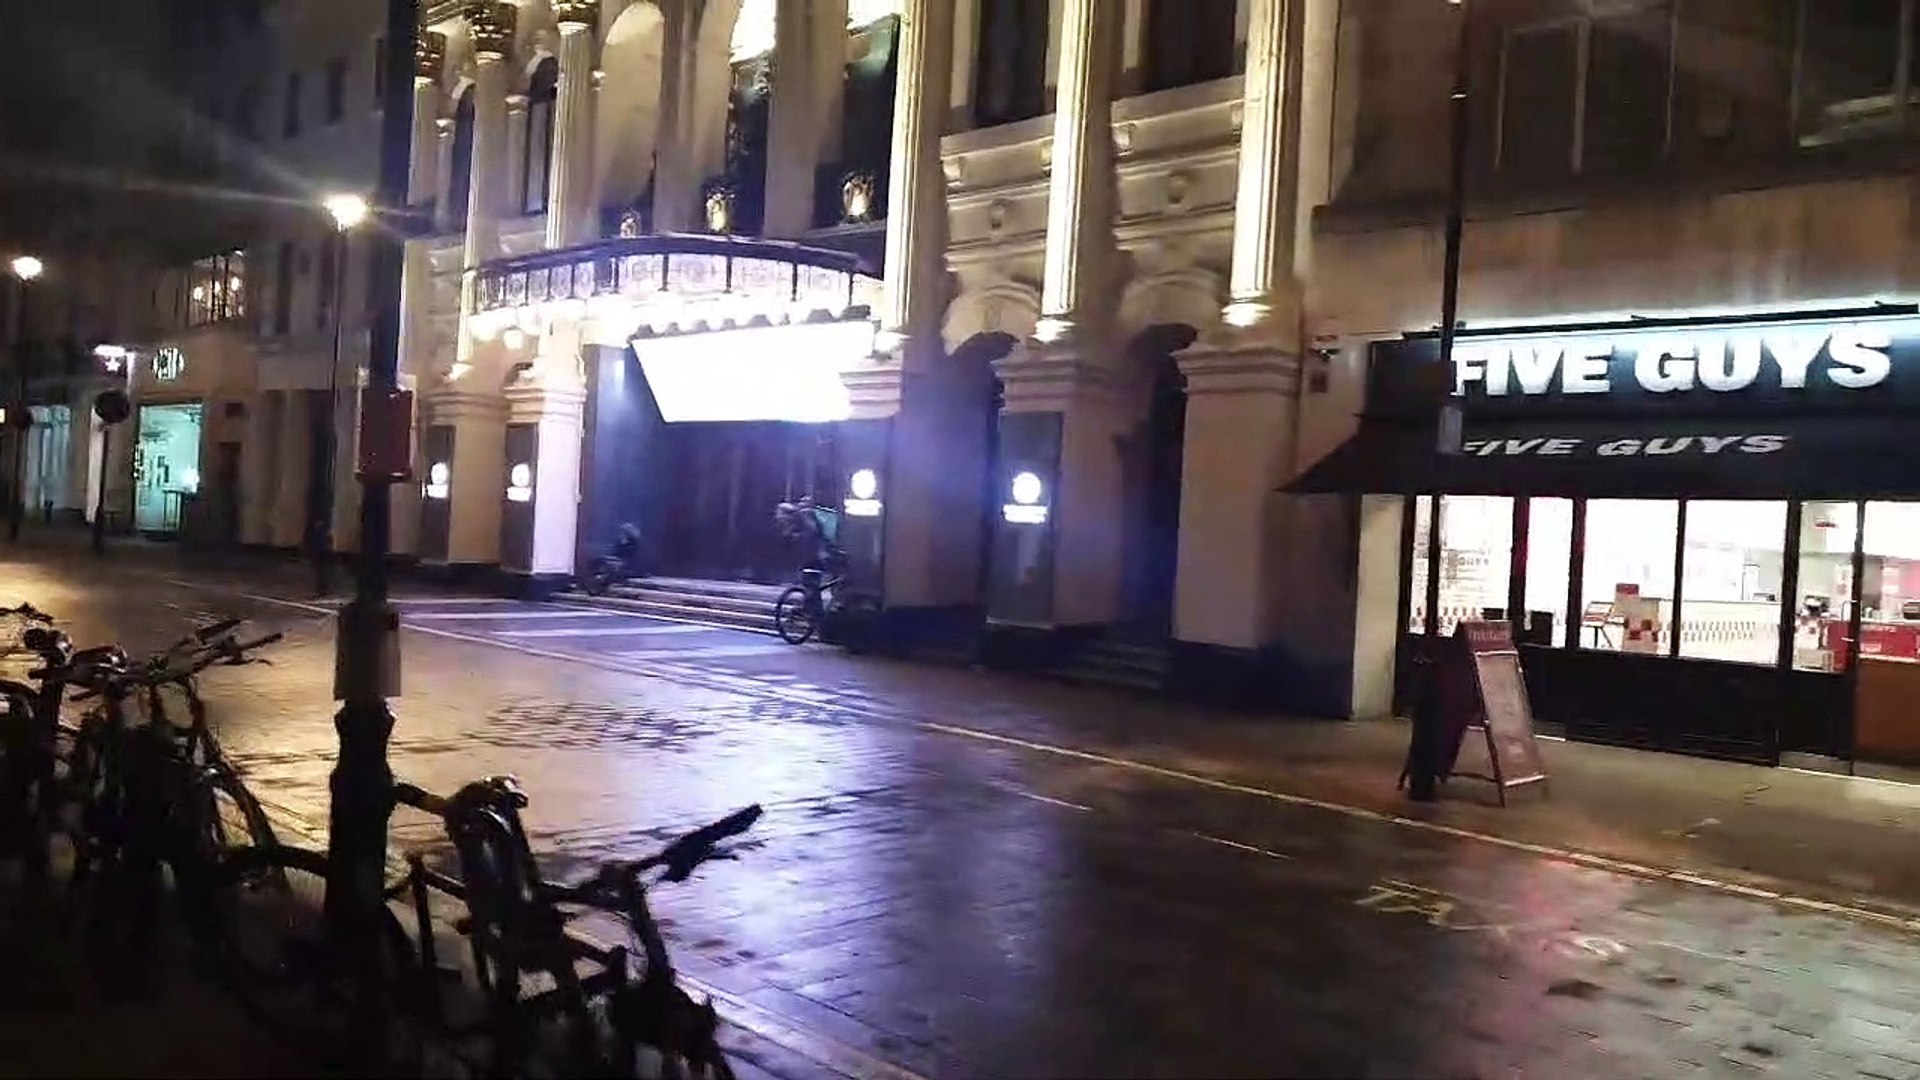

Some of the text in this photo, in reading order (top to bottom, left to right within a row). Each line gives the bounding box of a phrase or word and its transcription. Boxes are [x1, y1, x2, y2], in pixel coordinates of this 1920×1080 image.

[1451, 326, 1891, 396] FIVE GUYS
[1597, 434, 1793, 456] GUYS
